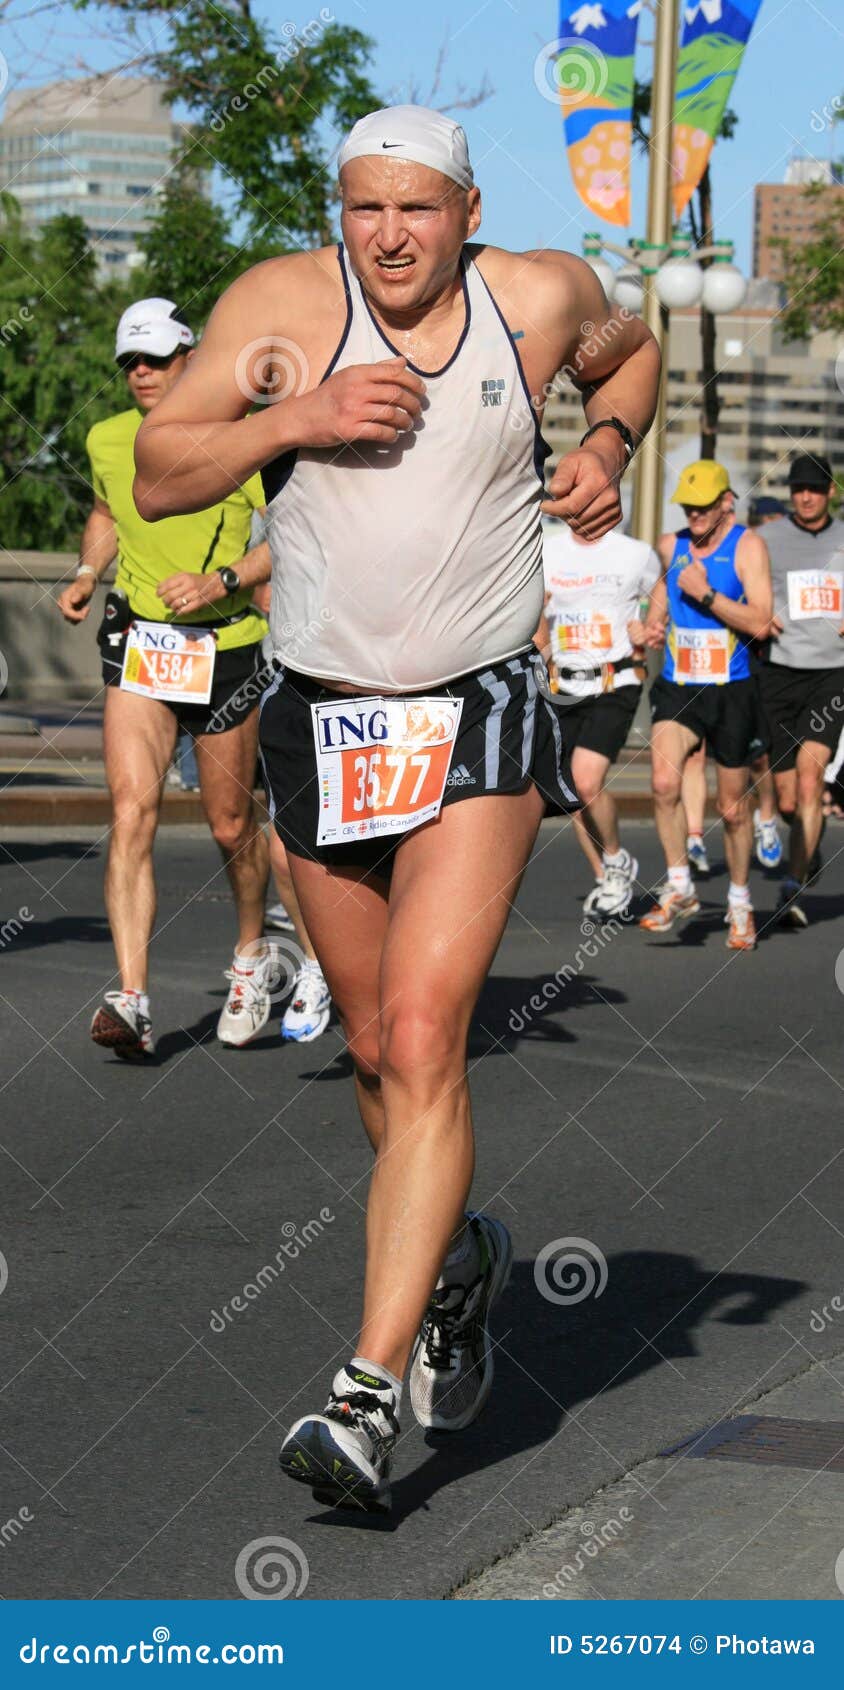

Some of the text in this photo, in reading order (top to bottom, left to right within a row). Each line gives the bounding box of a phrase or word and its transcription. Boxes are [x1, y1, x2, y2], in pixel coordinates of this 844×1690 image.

[558, 612, 588, 624] ING
[677, 634, 702, 647] ING
[148, 652, 193, 684] 1584
[320, 710, 389, 748] ING
[353, 752, 432, 812] 3577
[447, 776, 477, 786] didas
